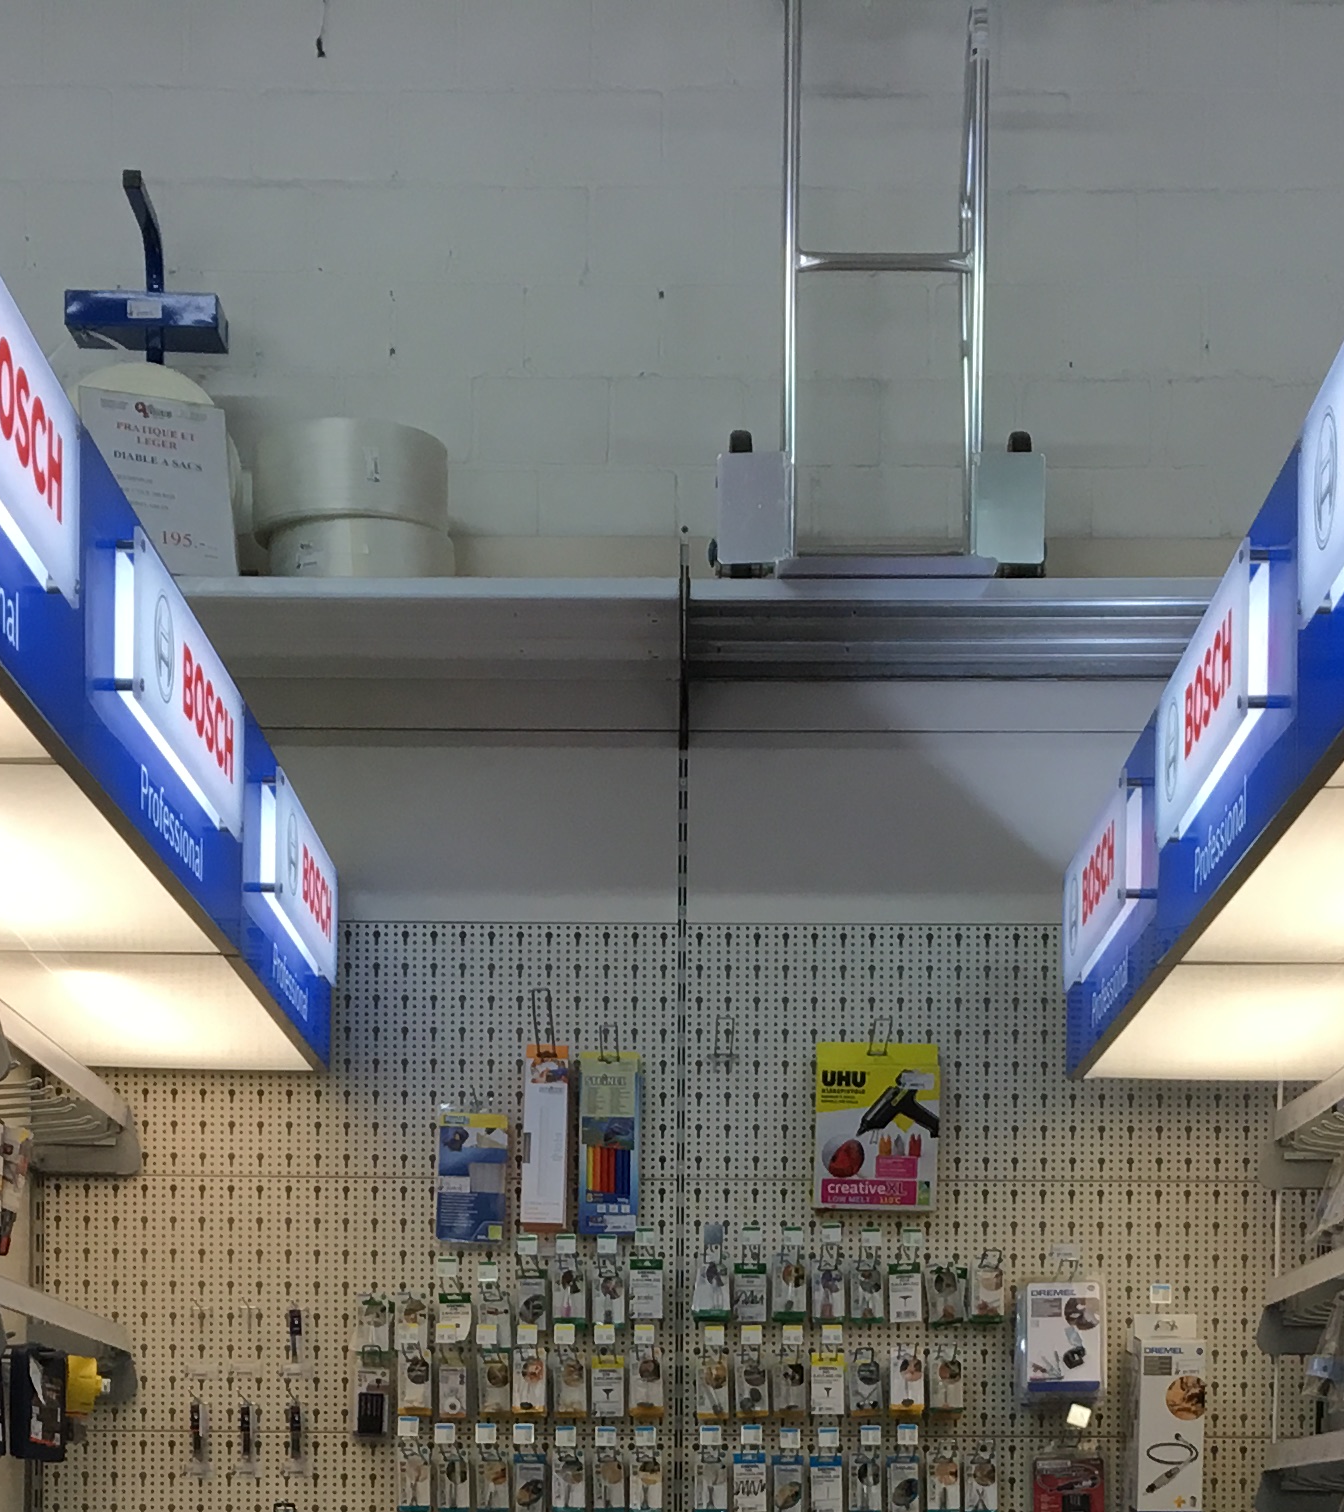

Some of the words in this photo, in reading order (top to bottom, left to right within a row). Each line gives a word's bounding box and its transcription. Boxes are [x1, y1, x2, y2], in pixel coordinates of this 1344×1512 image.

[113, 450, 158, 466] DIABLE
[160, 458, 170, 467] A
[172, 459, 203, 472] SACS
[136, 436, 178, 450] LEGER
[183, 642, 234, 785] BOSCH
[1184, 608, 1232, 760] BOSCH
[139, 763, 204, 882] Professional
[1193, 774, 1248, 894] Professional
[302, 842, 332, 944] BOSCH
[1082, 819, 1115, 927] BOSCH
[272, 942, 309, 1022] Professional
[1090, 945, 1129, 1029] Professional
[821, 1069, 866, 1088] UHU
[1030, 1288, 1077, 1297] DREMEL
[1143, 1346, 1184, 1355] DREMEL
